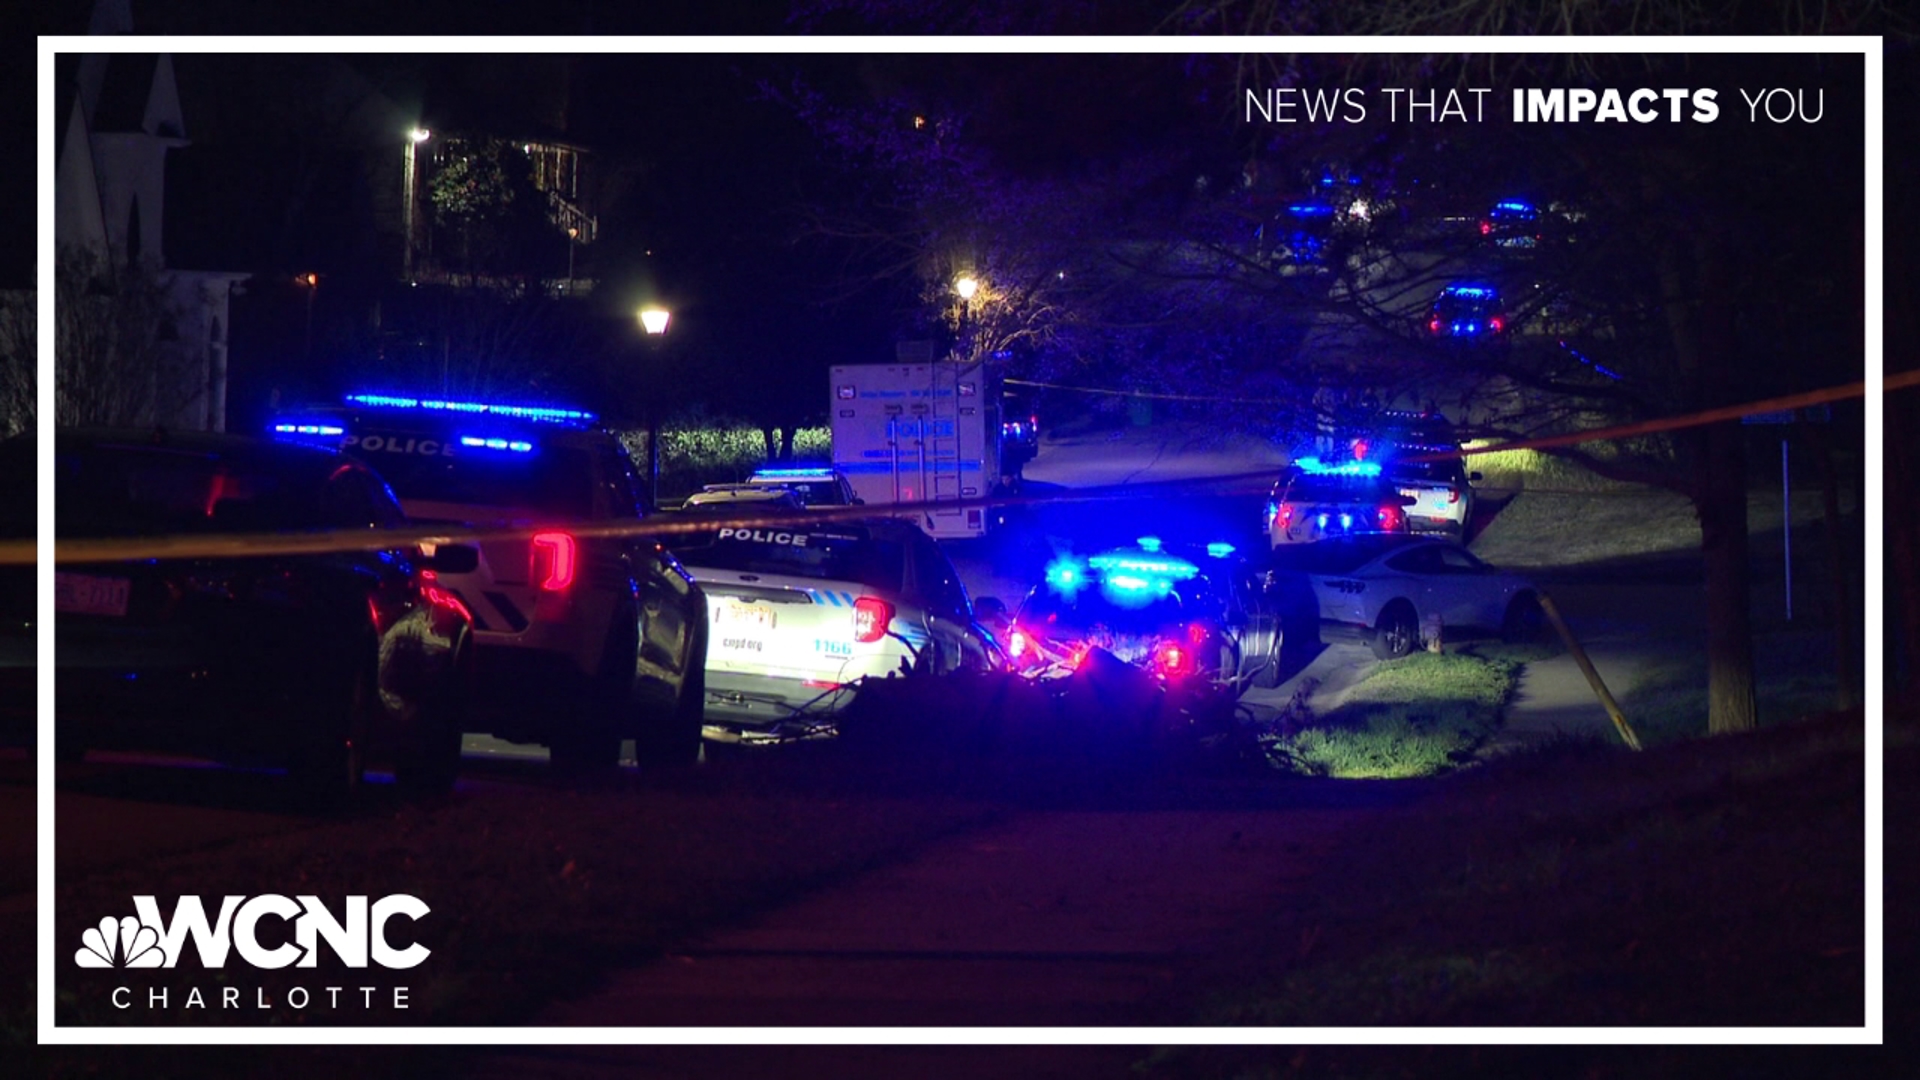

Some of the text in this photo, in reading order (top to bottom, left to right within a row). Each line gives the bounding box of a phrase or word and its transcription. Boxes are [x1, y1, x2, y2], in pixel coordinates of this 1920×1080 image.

[338, 434, 458, 457] POLICE
[718, 527, 809, 547] POLICE
[722, 637, 763, 652] cmpdorg
[813, 638, 853, 655] 1166
